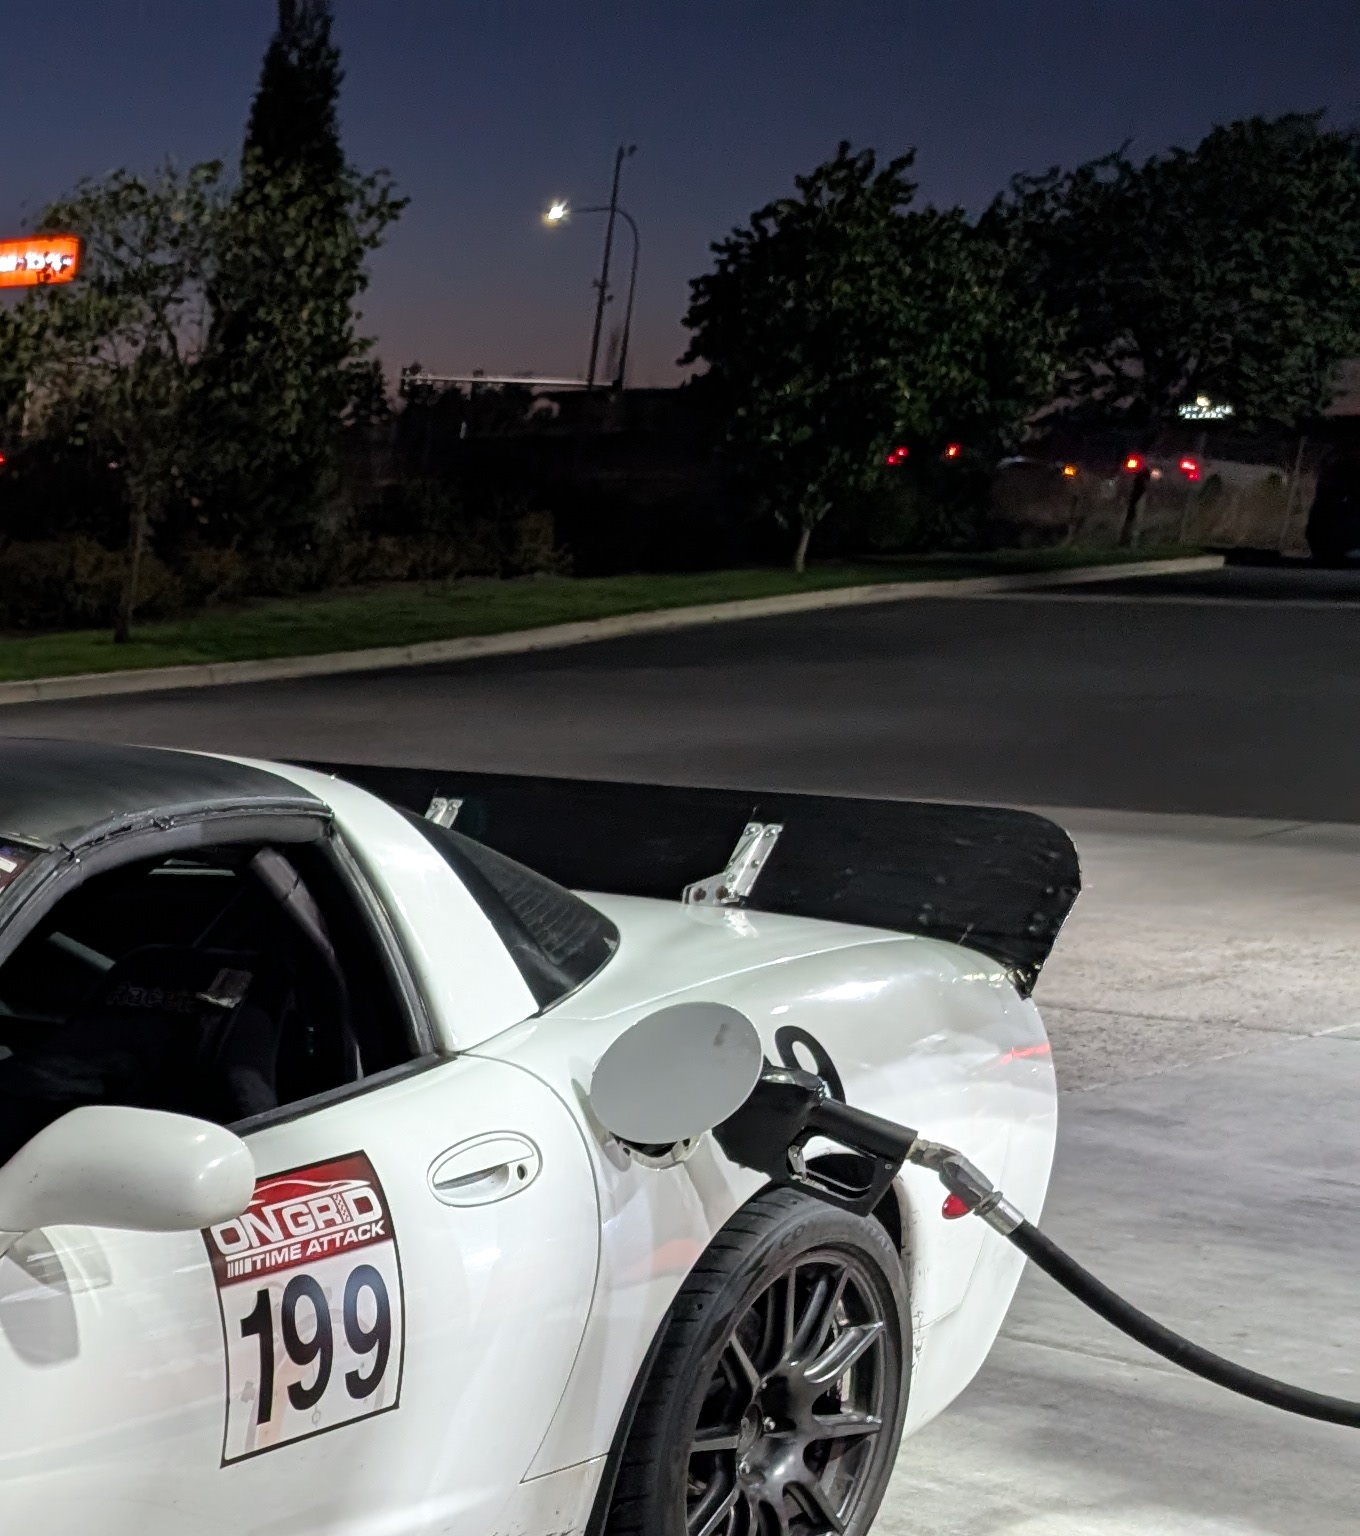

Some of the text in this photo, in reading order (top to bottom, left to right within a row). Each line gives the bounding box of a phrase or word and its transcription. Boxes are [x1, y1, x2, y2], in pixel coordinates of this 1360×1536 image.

[252, 1219, 386, 1272] TIME ATTACK
[240, 1264, 392, 1426] 199
